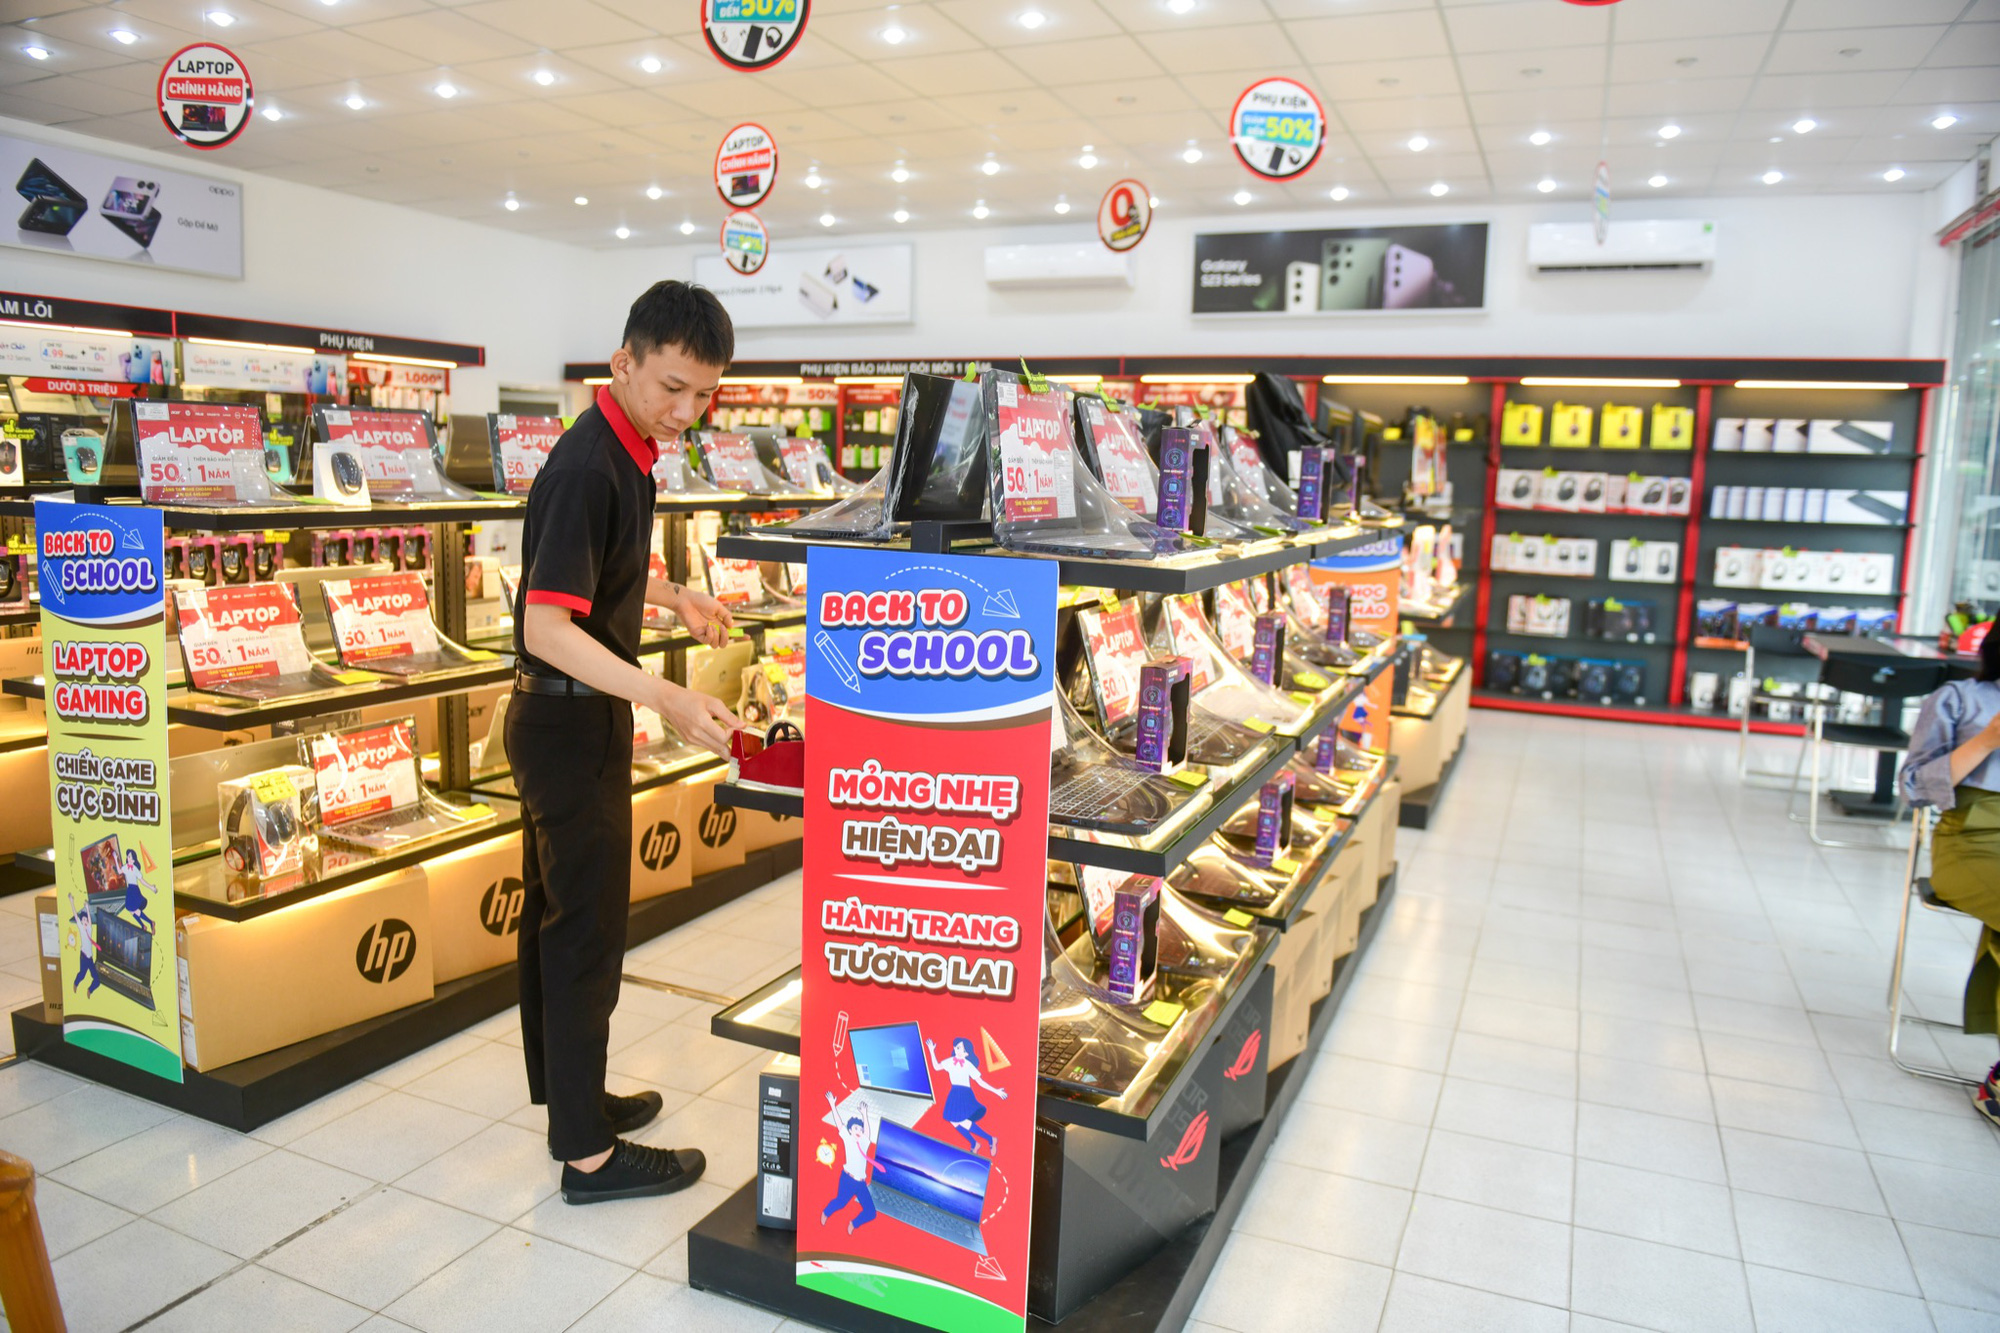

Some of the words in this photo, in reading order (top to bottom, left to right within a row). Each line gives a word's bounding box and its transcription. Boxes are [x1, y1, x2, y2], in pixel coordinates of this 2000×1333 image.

[177, 60, 235, 75] LAPTOP
[169, 80, 206, 96] CHÍNH
[208, 82, 242, 97] HÃNG
[1266, 117, 1313, 141] 50%
[727, 136, 764, 151] LAPTOP
[1201, 259, 1248, 273] Galaxy
[1201, 274, 1221, 287] S23
[1223, 273, 1262, 286] Series
[24, 301, 53, 319] LÕI
[319, 333, 343, 348] PHỤ
[347, 335, 375, 352] KIỆN
[800, 363, 822, 377] PHỤ
[824, 363, 850, 377] KIỆN
[851, 361, 874, 375] BẢO
[876, 361, 906, 375] HÀNH
[932, 361, 954, 374] MỚI
[47, 381, 77, 392] DƯỚI
[79, 384, 85, 392] 3
[87, 384, 118, 395] TRIỆU
[169, 427, 244, 444] LAPTOP
[352, 430, 414, 444] LAPTOP
[1017, 417, 1060, 440] LAPTOP
[150, 463, 186, 483] 50%
[197, 465, 206, 482] 1
[208, 468, 231, 479] NĂM
[379, 462, 387, 477] 1
[388, 466, 406, 475] NĂM
[1007, 467, 1028, 493] 50%
[1034, 469, 1039, 493] 1
[1040, 474, 1053, 488] NĂM
[44, 531, 85, 555] BACK
[88, 530, 112, 555] TO
[62, 559, 154, 590] SCHOOL
[352, 594, 412, 612] LAPTOP
[822, 593, 913, 623] BACK
[918, 592, 964, 623] TO
[208, 606, 280, 627] LAPTOP
[378, 628, 387, 642] 1
[387, 631, 405, 640] NĂM
[1103, 630, 1134, 654] LAPTOP
[54, 645, 145, 675] LAPTOP
[193, 647, 227, 667] 50%
[237, 645, 247, 661] 1
[248, 647, 270, 657] NĂM
[860, 634, 1034, 672] SCHOOL
[55, 685, 144, 717] GAMING
[56, 749, 98, 776] CHIẾN
[102, 759, 152, 781] GAME
[338, 745, 397, 770] APTOP
[360, 783, 367, 798] 1
[368, 783, 386, 793] NĂM
[832, 764, 931, 804] MỎNG
[939, 779, 1014, 814] NHẸ
[57, 787, 97, 817] CỰC
[101, 784, 156, 818] ĐỈNH
[644, 821, 677, 871] hp
[846, 821, 923, 859] HIỆN
[931, 832, 995, 865] ĐẠI
[486, 877, 525, 936] hp
[825, 901, 904, 933] HÀNH
[911, 913, 1014, 942] TRANG
[363, 919, 411, 984] hp
[828, 946, 943, 983] TƯƠNG
[951, 961, 1008, 990] LAI
